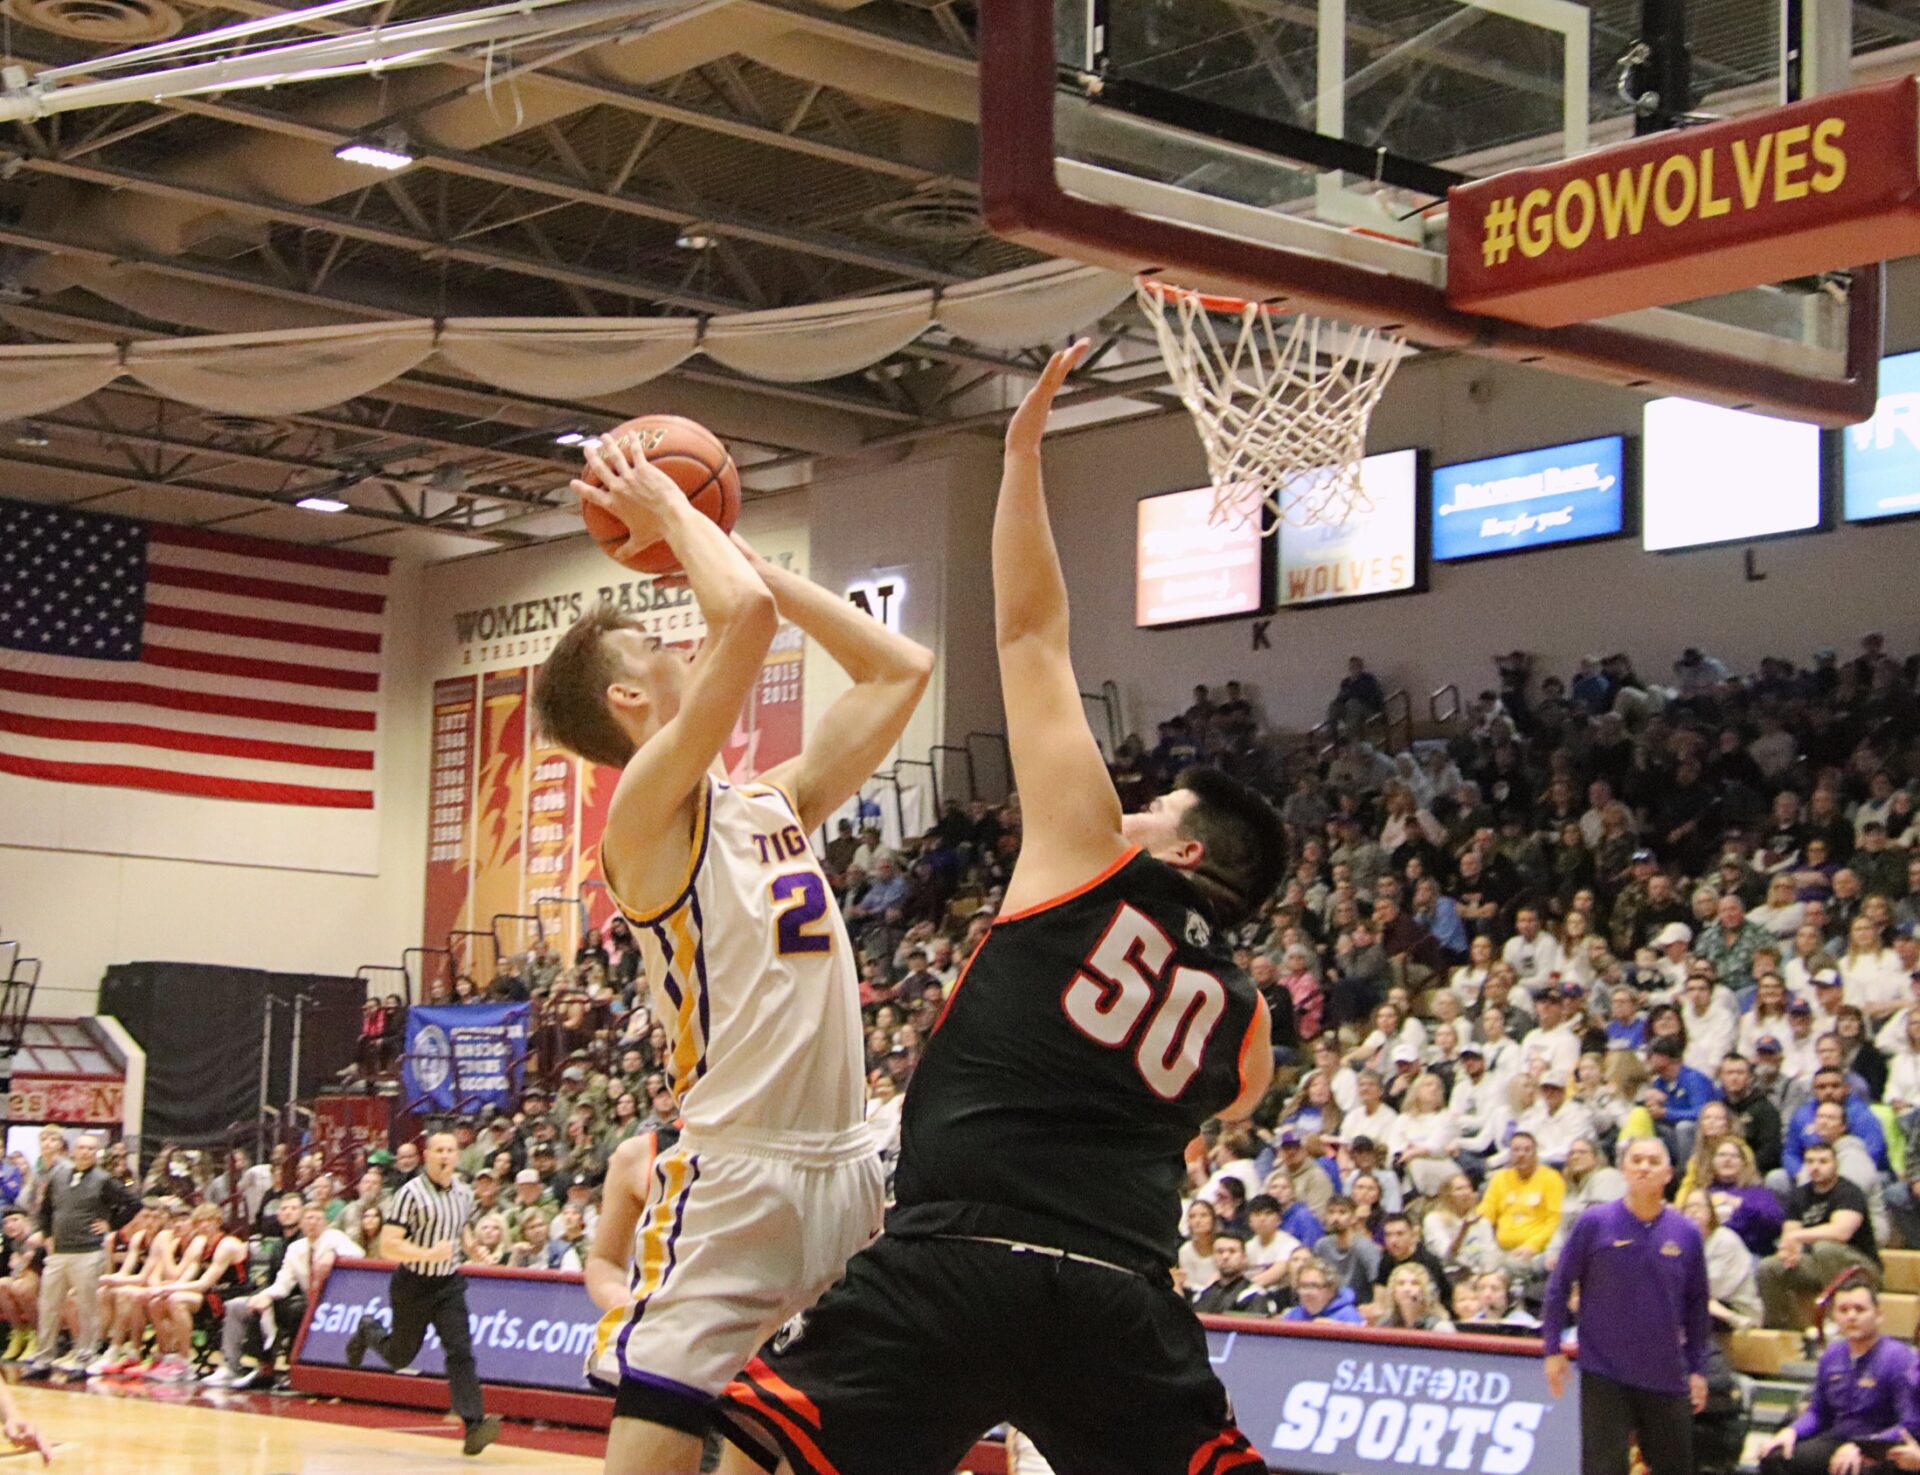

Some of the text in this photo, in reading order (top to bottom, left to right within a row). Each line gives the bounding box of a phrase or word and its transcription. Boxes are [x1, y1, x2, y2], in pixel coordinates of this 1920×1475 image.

[1482, 117, 1848, 268] #GOWOLVES
[1287, 555, 1405, 600] WOLVES
[1744, 549, 1767, 582] L
[454, 590, 583, 646] WOMEN'S
[1252, 621, 1271, 650] K
[751, 825, 807, 864] TIG
[769, 870, 832, 958] 2
[1060, 899, 1229, 1103] 50
[1331, 1358, 1511, 1406] SANFORD
[1270, 1380, 1546, 1475] SPORTS
